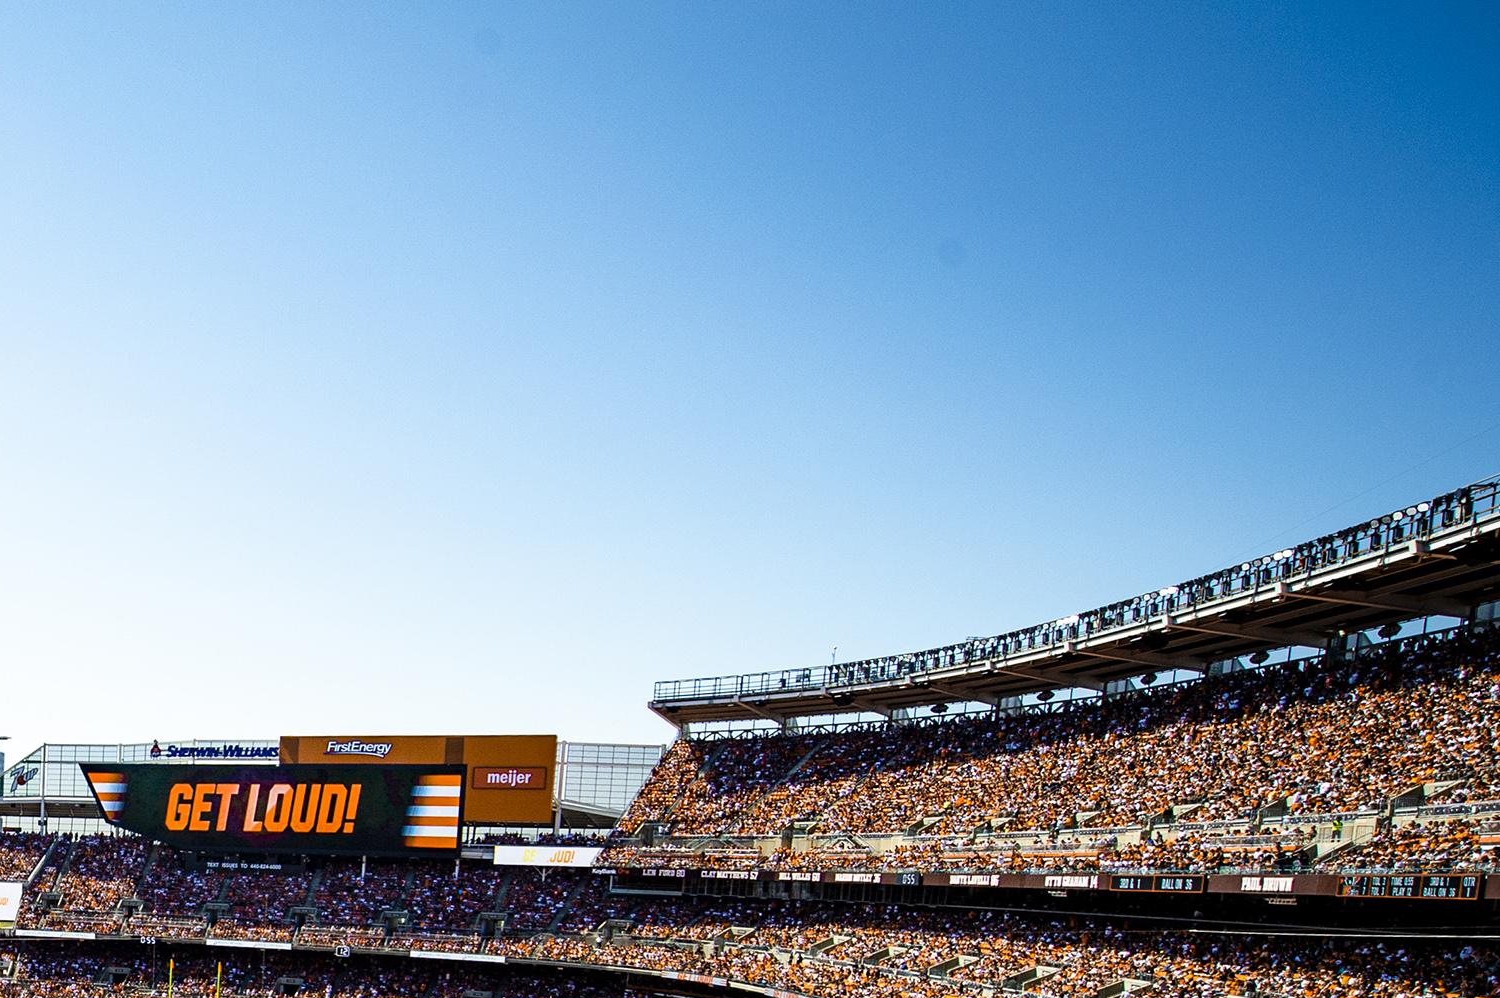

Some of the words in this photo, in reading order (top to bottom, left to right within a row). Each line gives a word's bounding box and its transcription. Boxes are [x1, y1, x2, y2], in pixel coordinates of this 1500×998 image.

[325, 740, 393, 758] FirstEnergy
[486, 769, 532, 787] meijer
[165, 782, 240, 832] GET
[244, 783, 362, 834] LOUD!
[750, 872, 759, 880] 57
[1090, 876, 1099, 888] 14
[1391, 877, 1402, 886] TIME
[1463, 877, 1475, 887] QTR
[1161, 878, 1174, 889] BALL
[1175, 879, 1183, 890] ON
[1241, 877, 1262, 891] PAUL
[1262, 877, 1294, 892] BROWN
[1392, 887, 1405, 897] PLAY
[1423, 887, 1437, 897] BALL
[1437, 887, 1447, 897] ON
